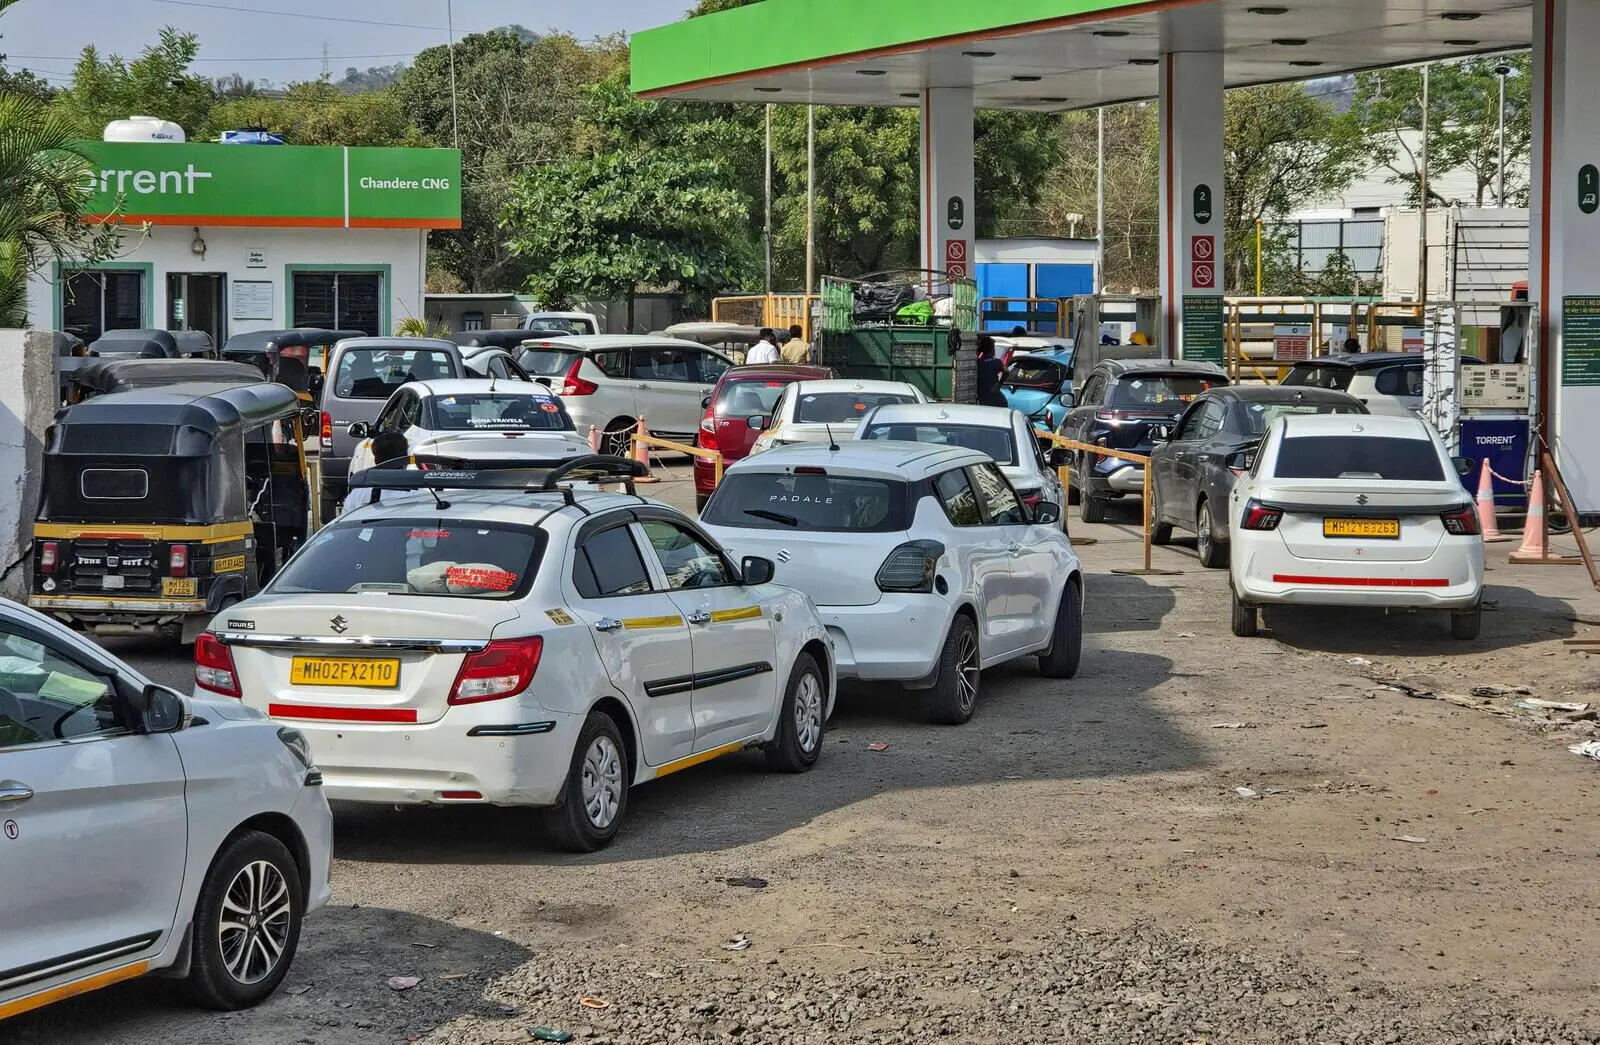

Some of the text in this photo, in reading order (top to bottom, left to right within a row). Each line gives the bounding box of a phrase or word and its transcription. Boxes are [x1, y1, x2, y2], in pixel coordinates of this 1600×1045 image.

[360, 177, 449, 189] Chandere CNG
[1585, 173, 1591, 184] 1
[1200, 191, 1206, 200] 2
[1475, 435, 1516, 445] TORRENT
[769, 495, 832, 504] PADALE
[303, 662, 392, 680] MH02FX2110
